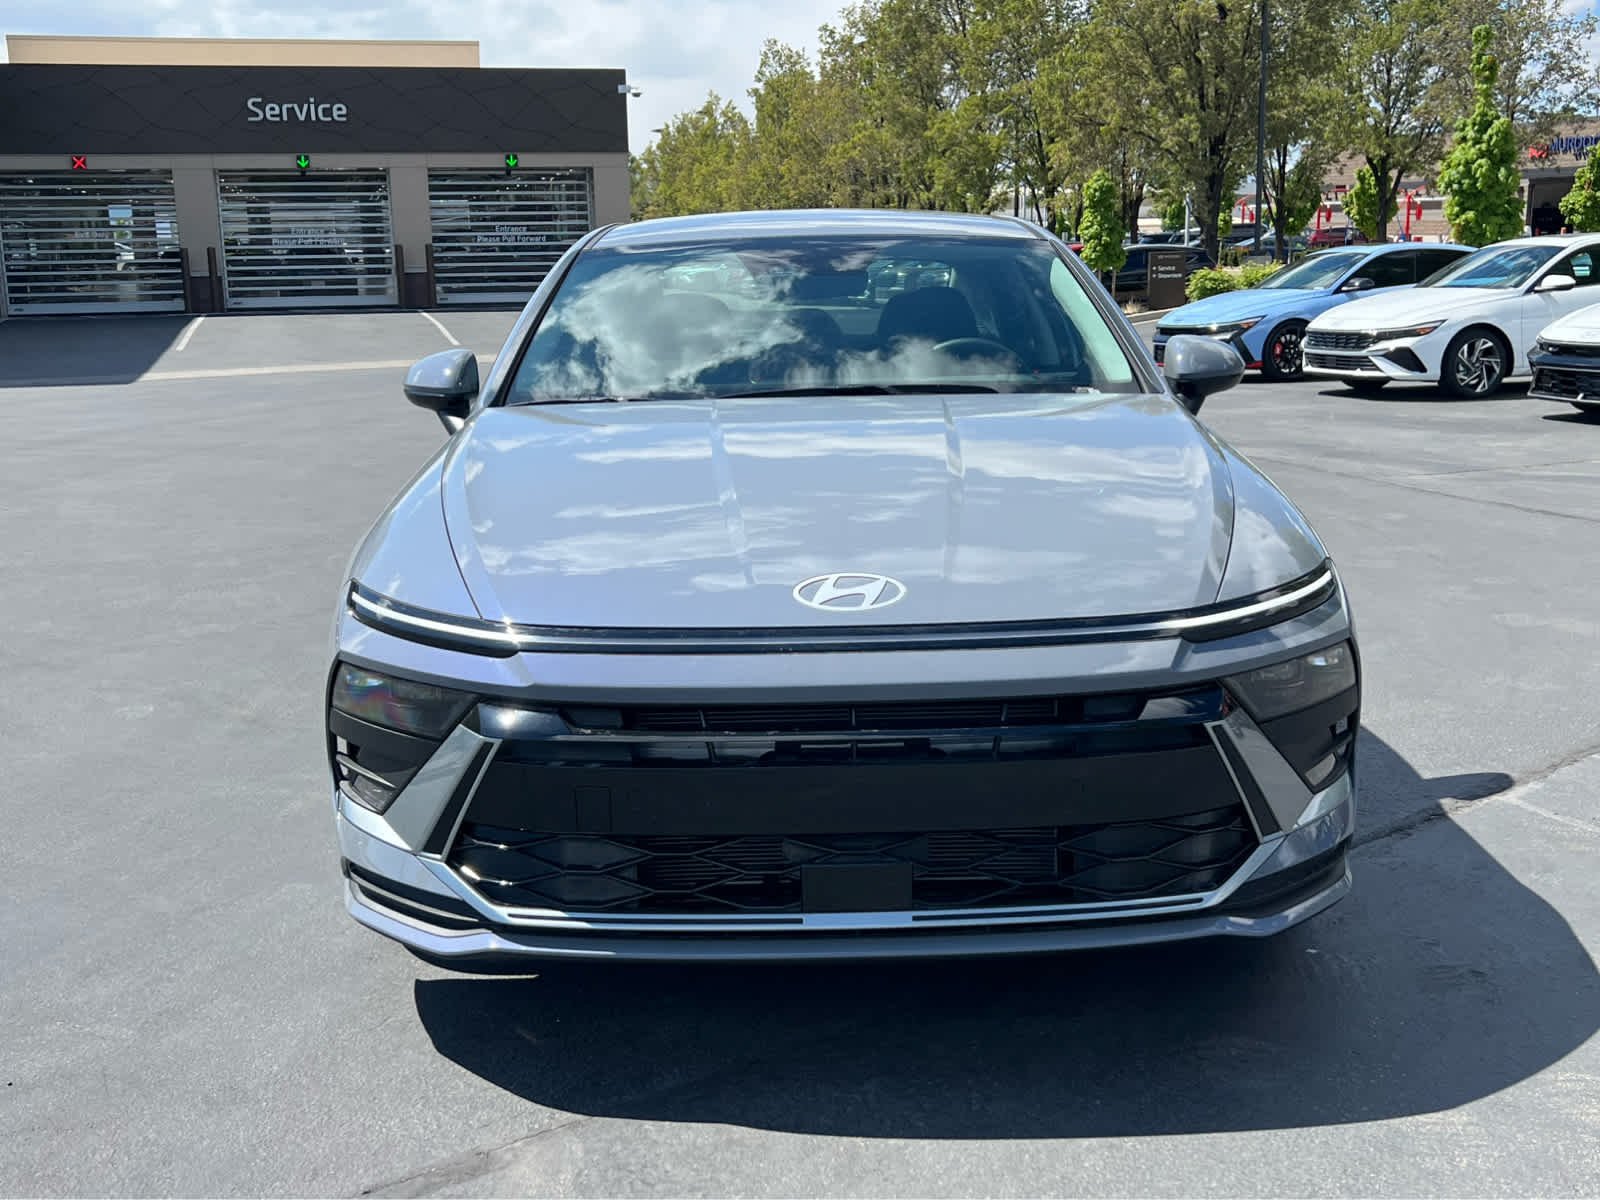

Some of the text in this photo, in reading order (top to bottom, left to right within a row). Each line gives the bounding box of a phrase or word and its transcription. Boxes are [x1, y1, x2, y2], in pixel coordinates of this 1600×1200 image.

[247, 97, 348, 121] Service
[495, 225, 528, 234] Entrance
[477, 234, 547, 244] Please Pull Forward
